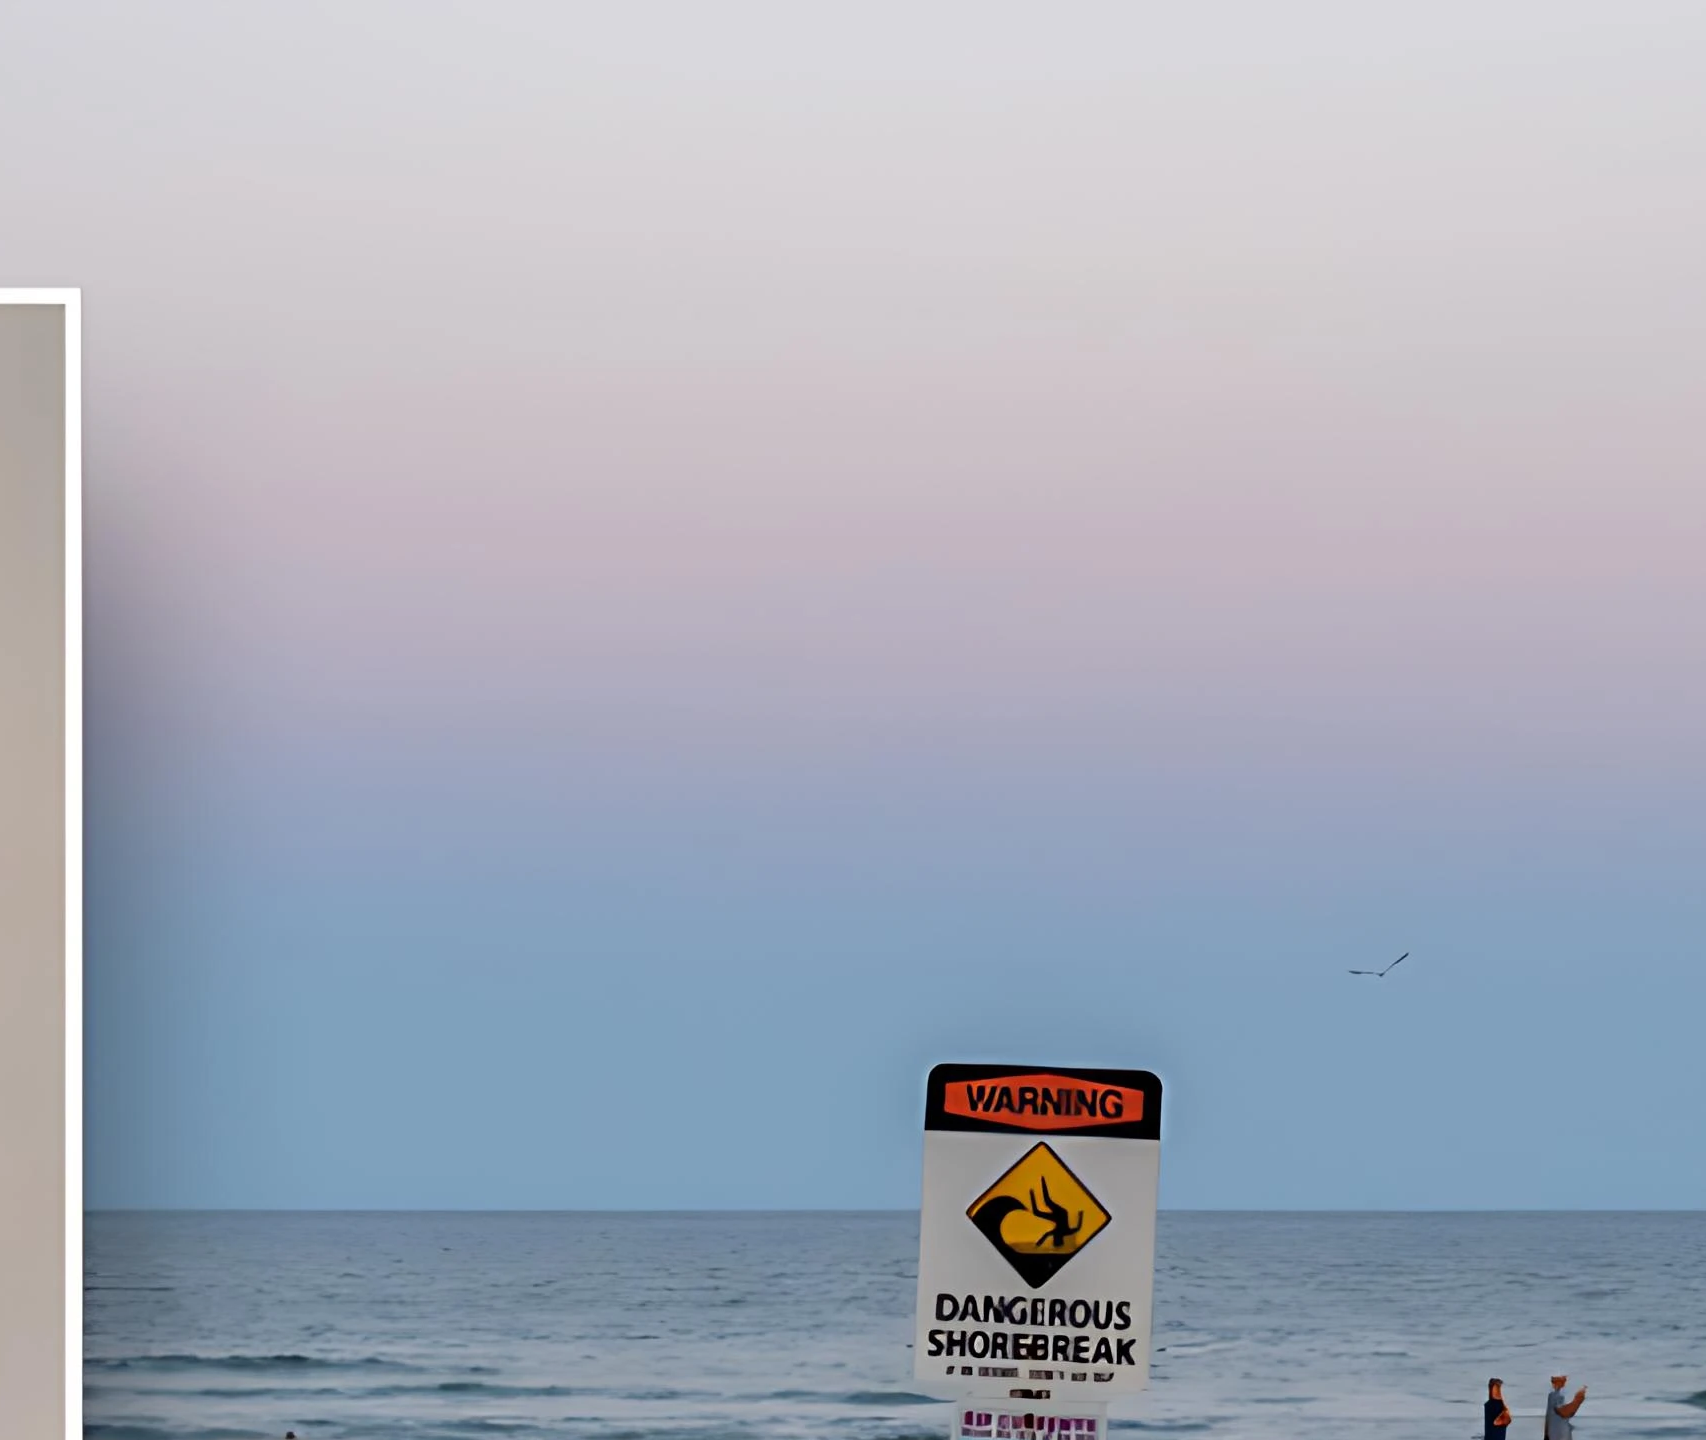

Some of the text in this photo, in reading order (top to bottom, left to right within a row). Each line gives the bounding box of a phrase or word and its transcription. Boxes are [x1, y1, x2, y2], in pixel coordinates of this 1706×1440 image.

[966, 1083, 1124, 1119] WARNING
[935, 1293, 1132, 1331] DANGEROUS
[927, 1329, 1137, 1366] SHOREBREAK
